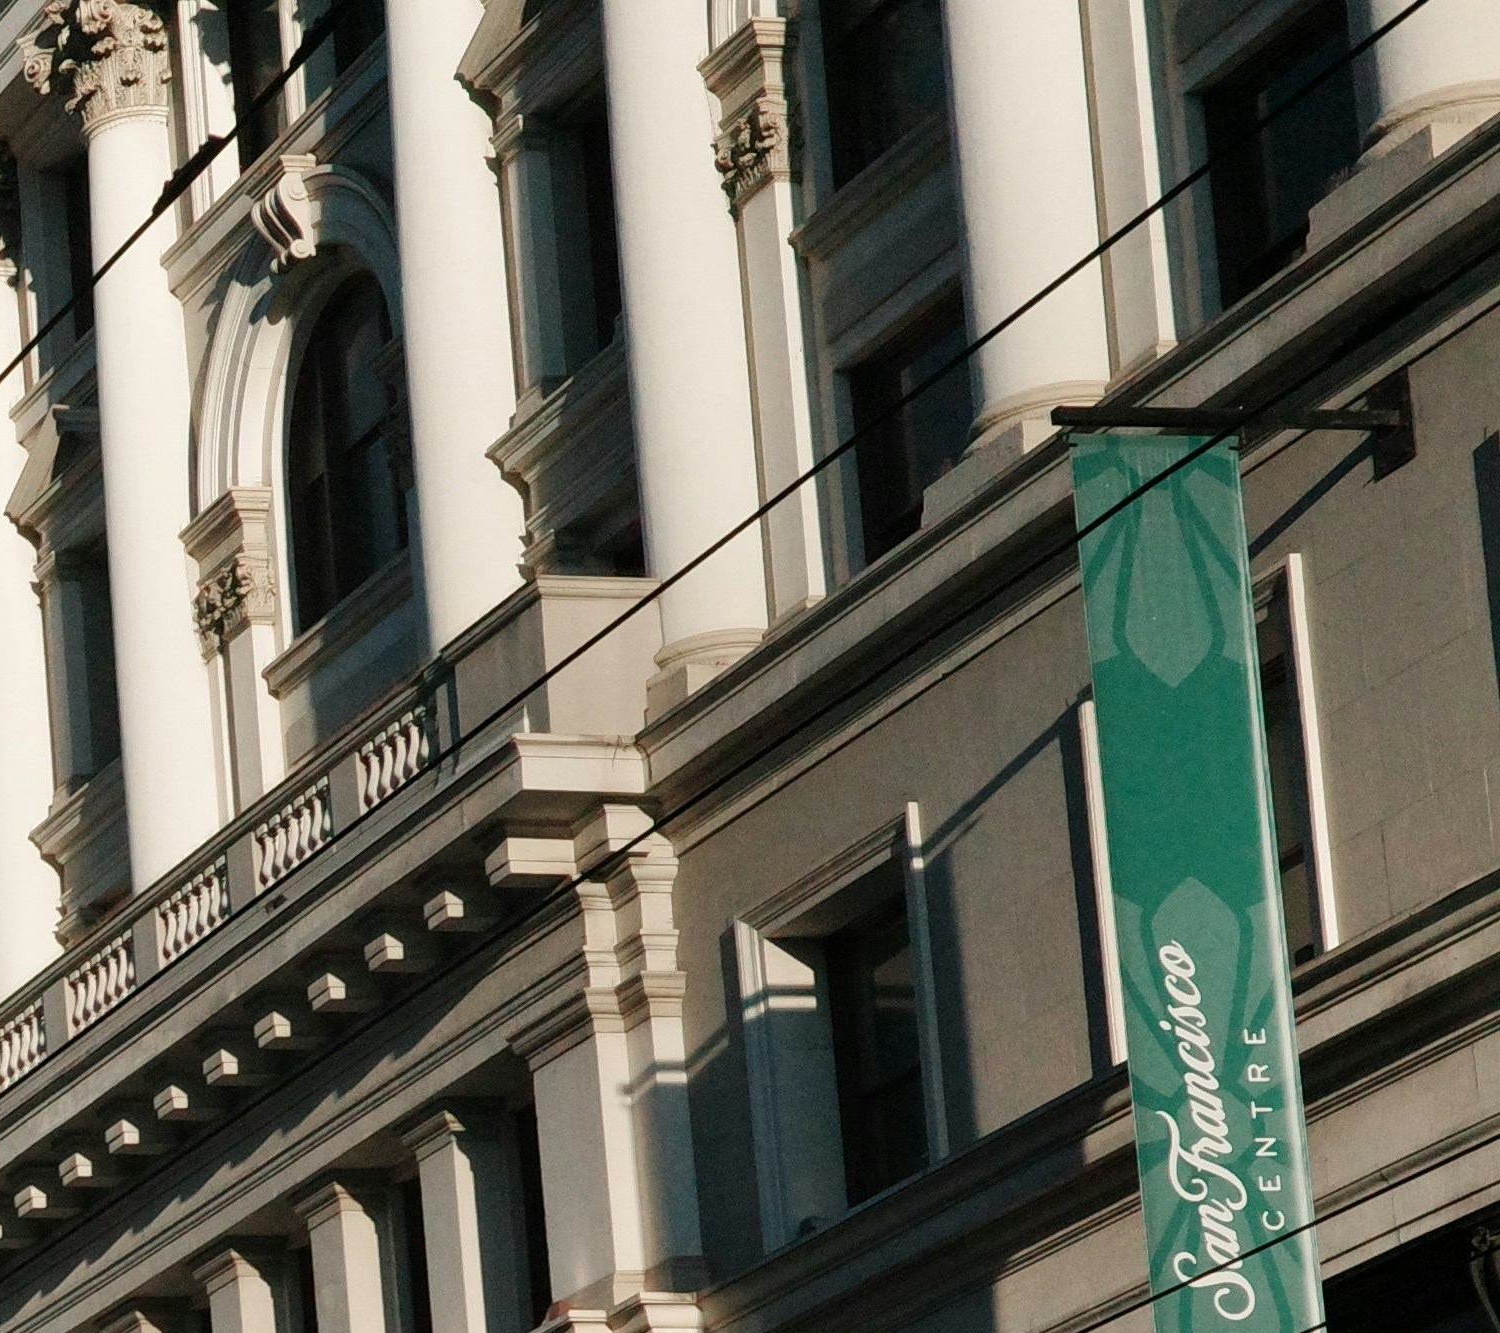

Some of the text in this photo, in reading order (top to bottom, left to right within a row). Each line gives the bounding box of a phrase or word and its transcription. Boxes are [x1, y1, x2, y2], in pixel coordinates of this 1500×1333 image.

[1155, 939, 1257, 1323] San Francisco
[1243, 1027, 1287, 1232] CENTRE
